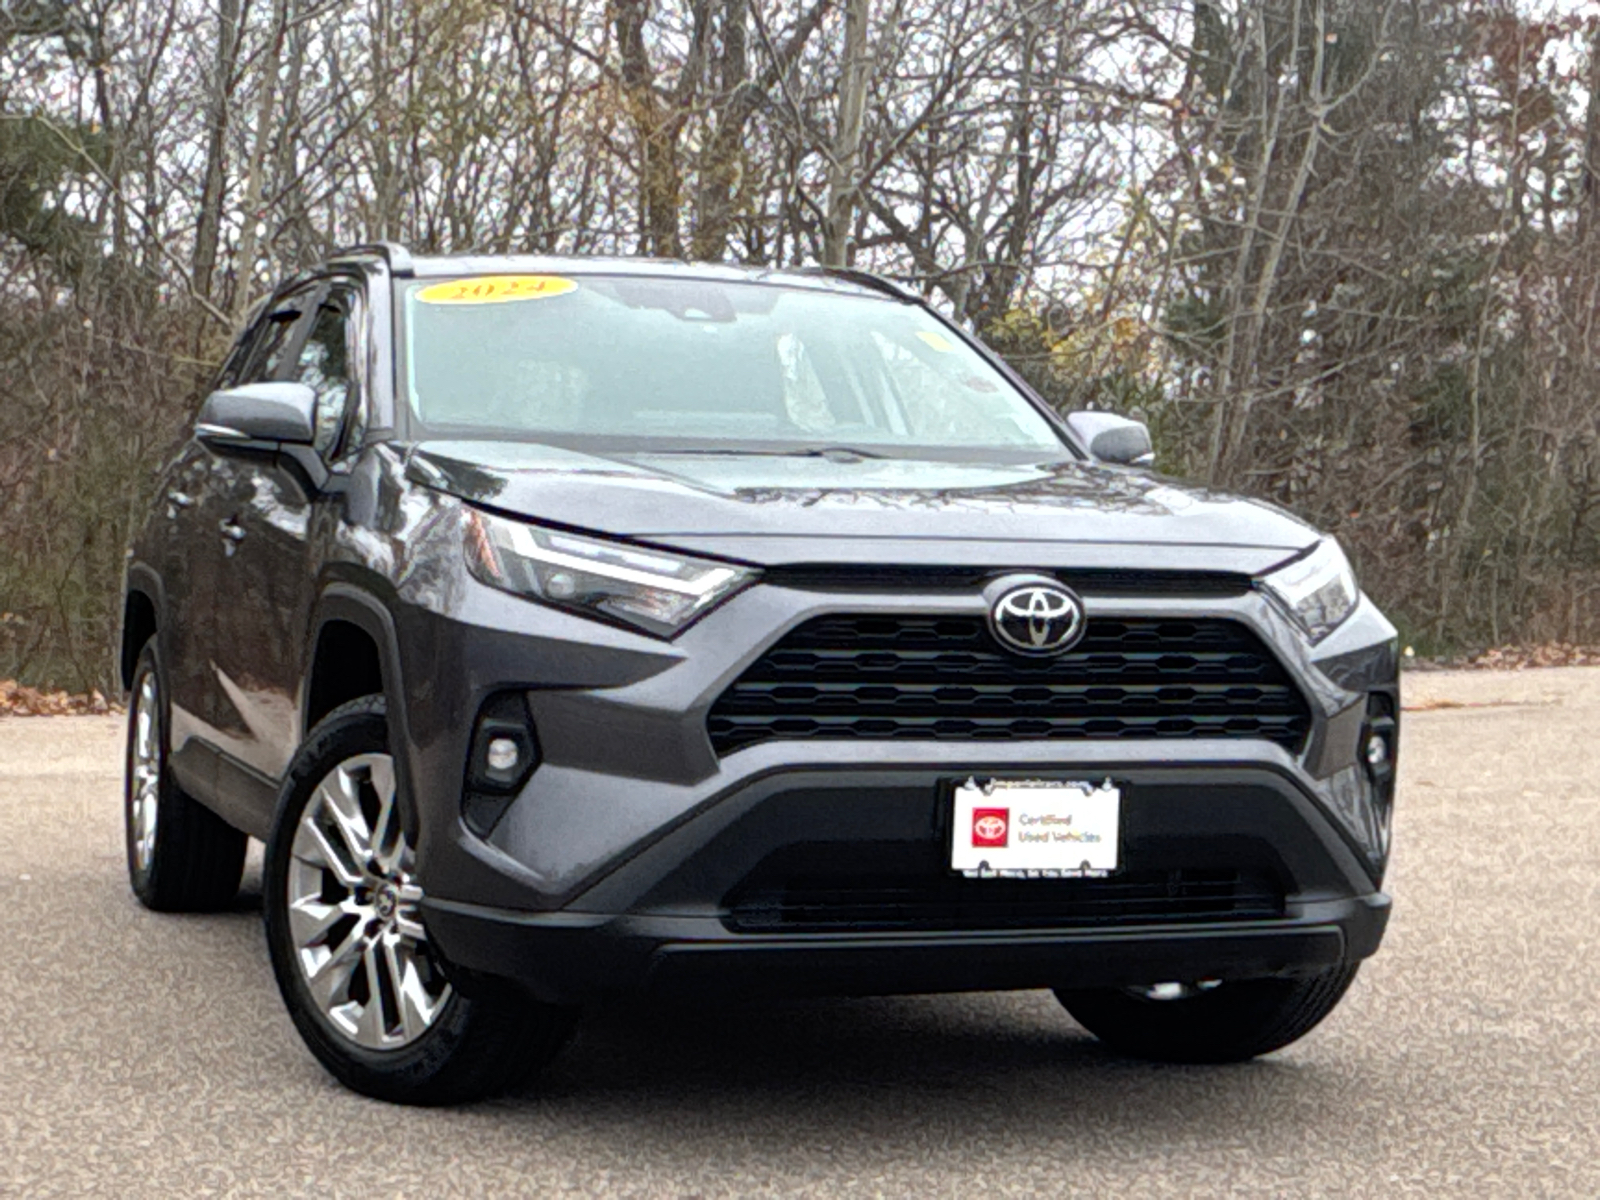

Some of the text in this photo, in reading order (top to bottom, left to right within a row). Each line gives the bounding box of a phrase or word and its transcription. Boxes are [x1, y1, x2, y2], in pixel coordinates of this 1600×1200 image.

[450, 280, 547, 299] 2024
[1018, 812, 1073, 826] Certified
[1018, 831, 1049, 843] Used
